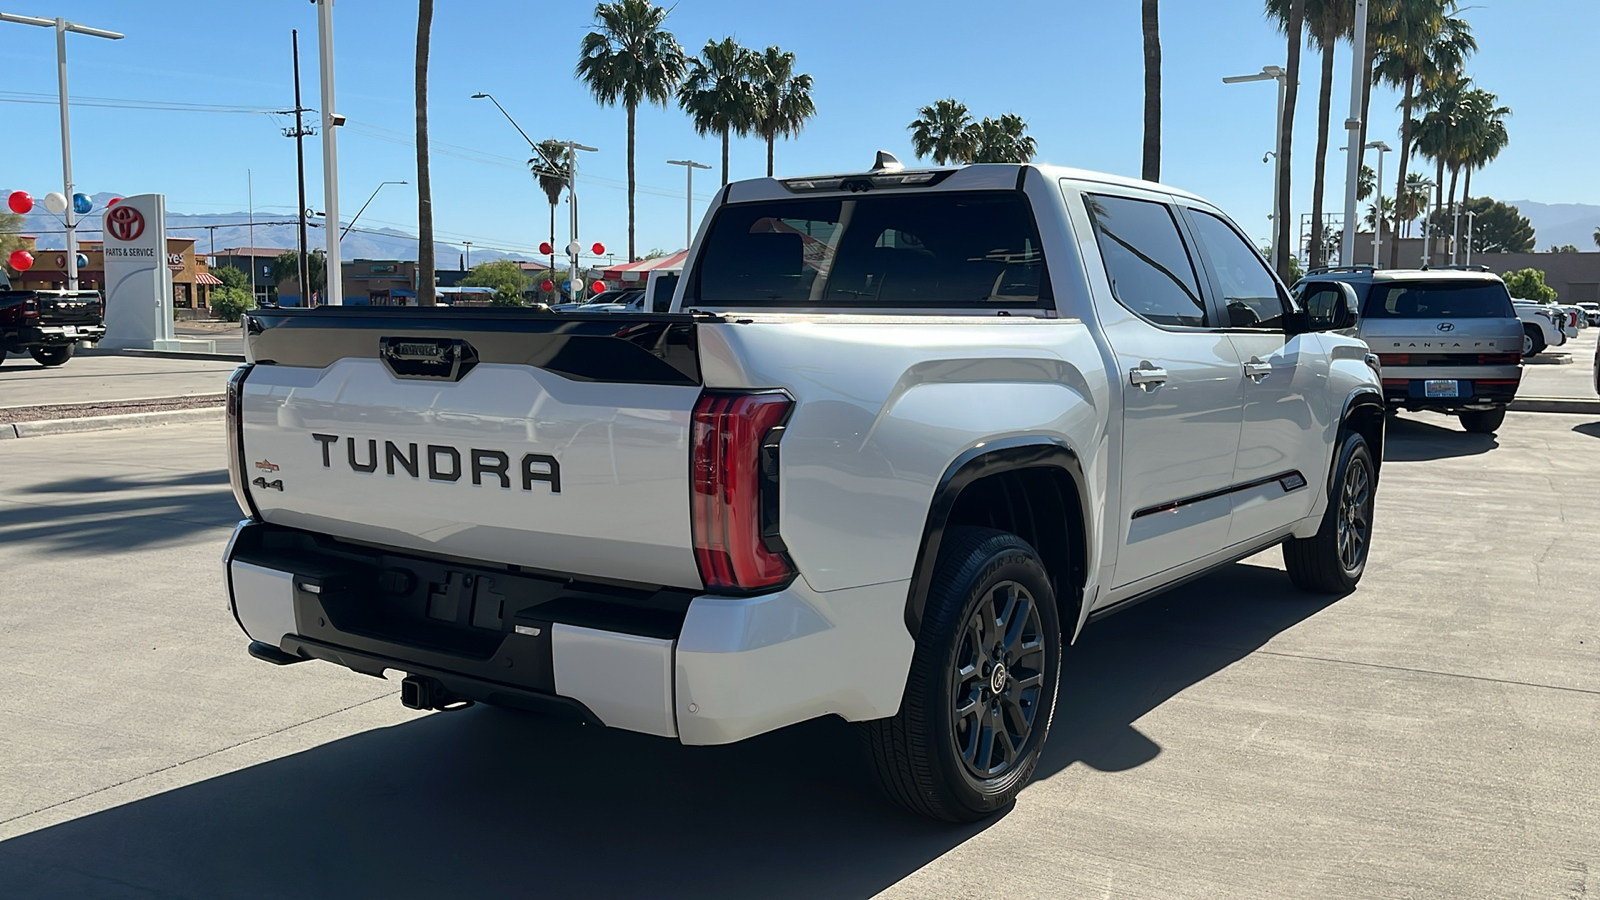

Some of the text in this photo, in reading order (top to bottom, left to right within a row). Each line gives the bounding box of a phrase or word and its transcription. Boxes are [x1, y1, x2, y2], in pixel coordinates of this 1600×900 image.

[105, 248, 154, 257] PARTS & SERVICE
[312, 433, 562, 493] TUNDRA
